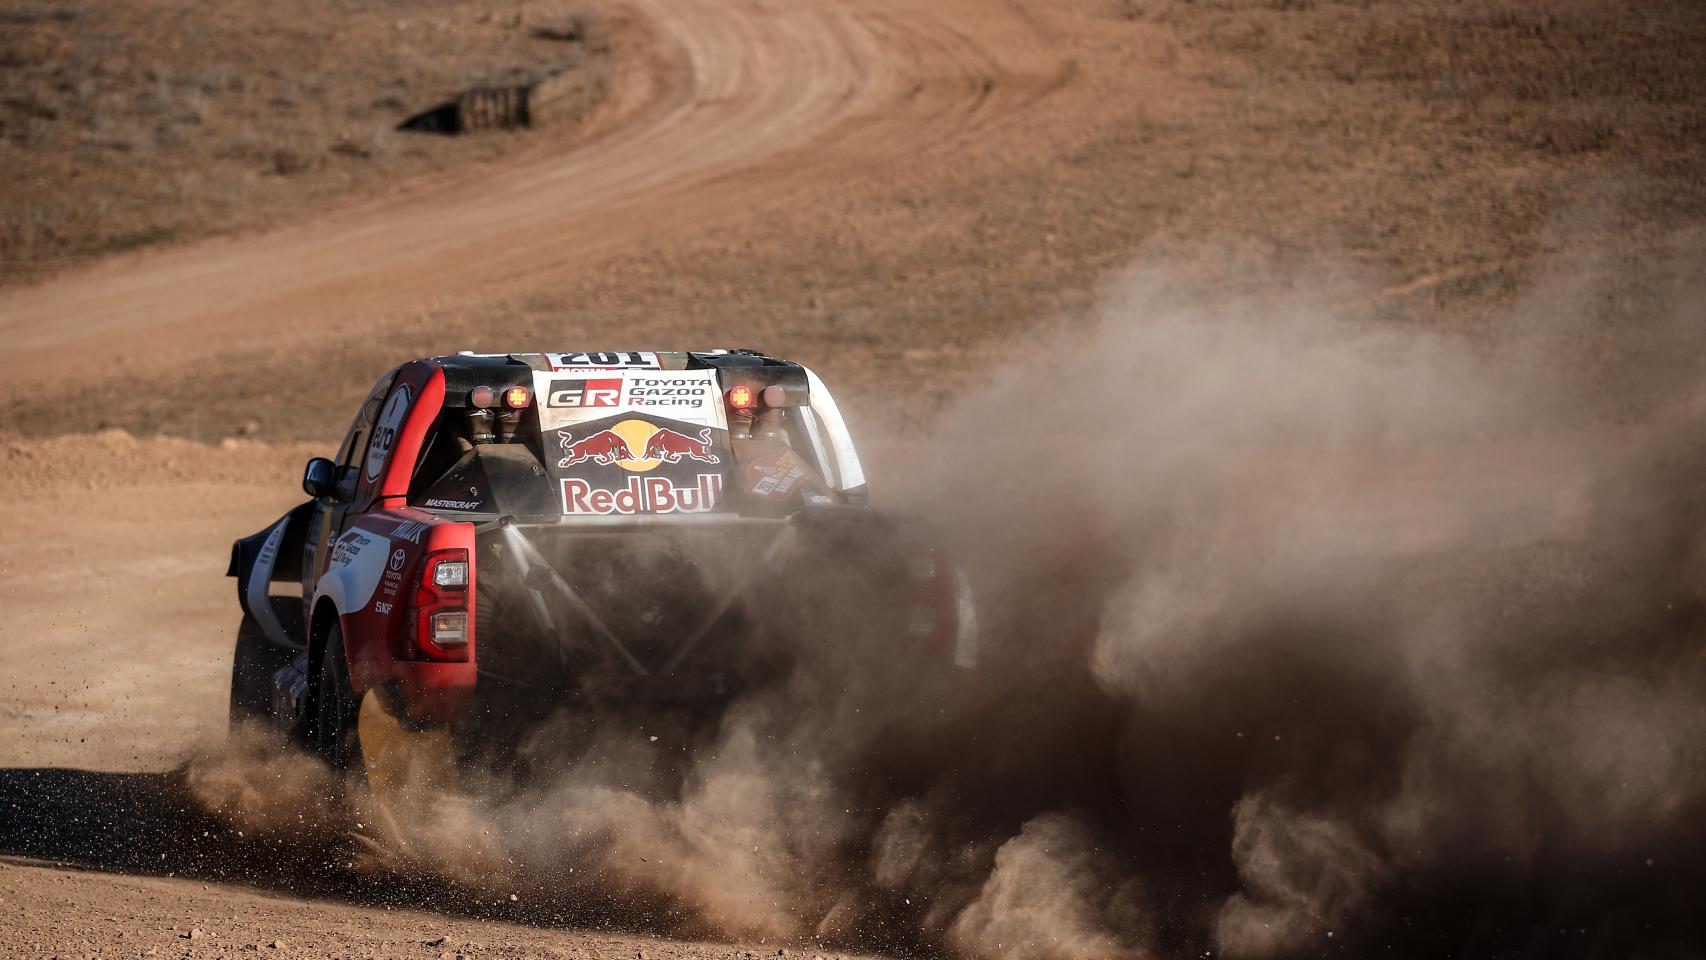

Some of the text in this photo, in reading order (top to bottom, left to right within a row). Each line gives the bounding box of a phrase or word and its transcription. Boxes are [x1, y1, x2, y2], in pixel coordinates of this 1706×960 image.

[557, 352, 651, 365] 201
[629, 378, 712, 387] TOYOTA
[629, 387, 705, 396] GAZOO
[549, 389, 619, 407] GR
[628, 397, 703, 408] Racing
[561, 474, 722, 514] Red Bull
[424, 498, 480, 509] MASTERCRAFT
[375, 601, 392, 615] SKF
